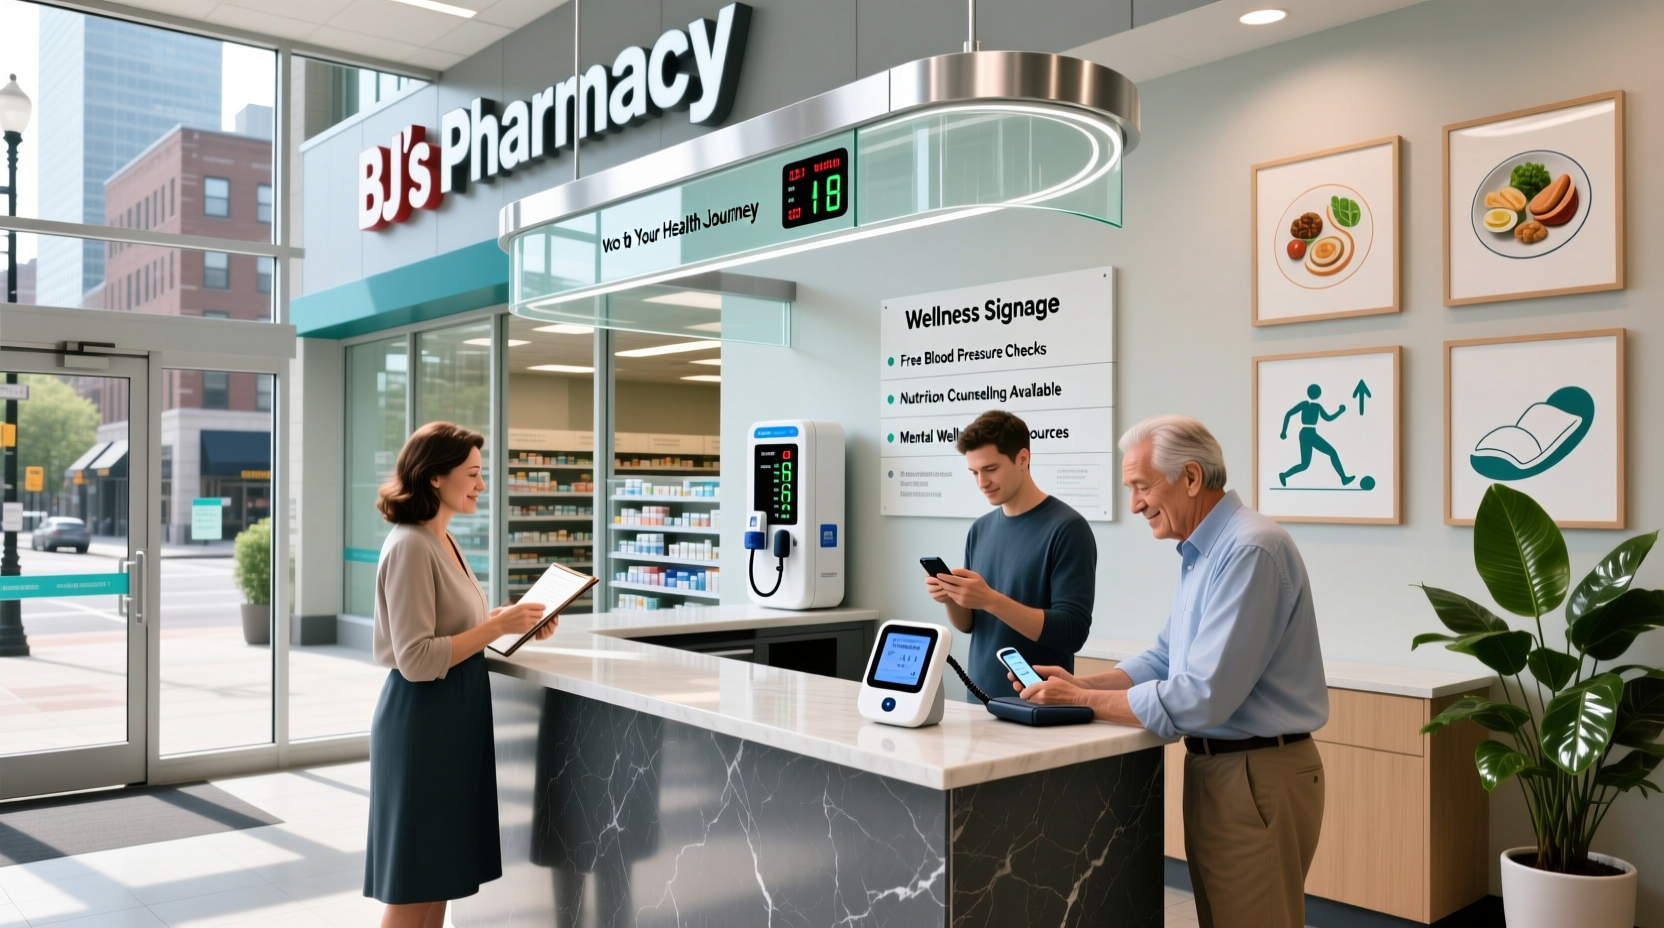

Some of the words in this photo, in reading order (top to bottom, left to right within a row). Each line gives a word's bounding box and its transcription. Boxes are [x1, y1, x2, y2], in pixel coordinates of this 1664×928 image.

[358, 125, 437, 231] BJ's
[440, 1, 742, 194] Pharmacy
[634, 227, 661, 247] Your
[663, 211, 701, 240] Health
[905, 305, 980, 330] Wellness
[984, 296, 1061, 325] Signage
[924, 348, 955, 365] Blood
[1005, 340, 1047, 358] Checks
[936, 427, 959, 443] Well
[1030, 427, 1070, 440] ources
